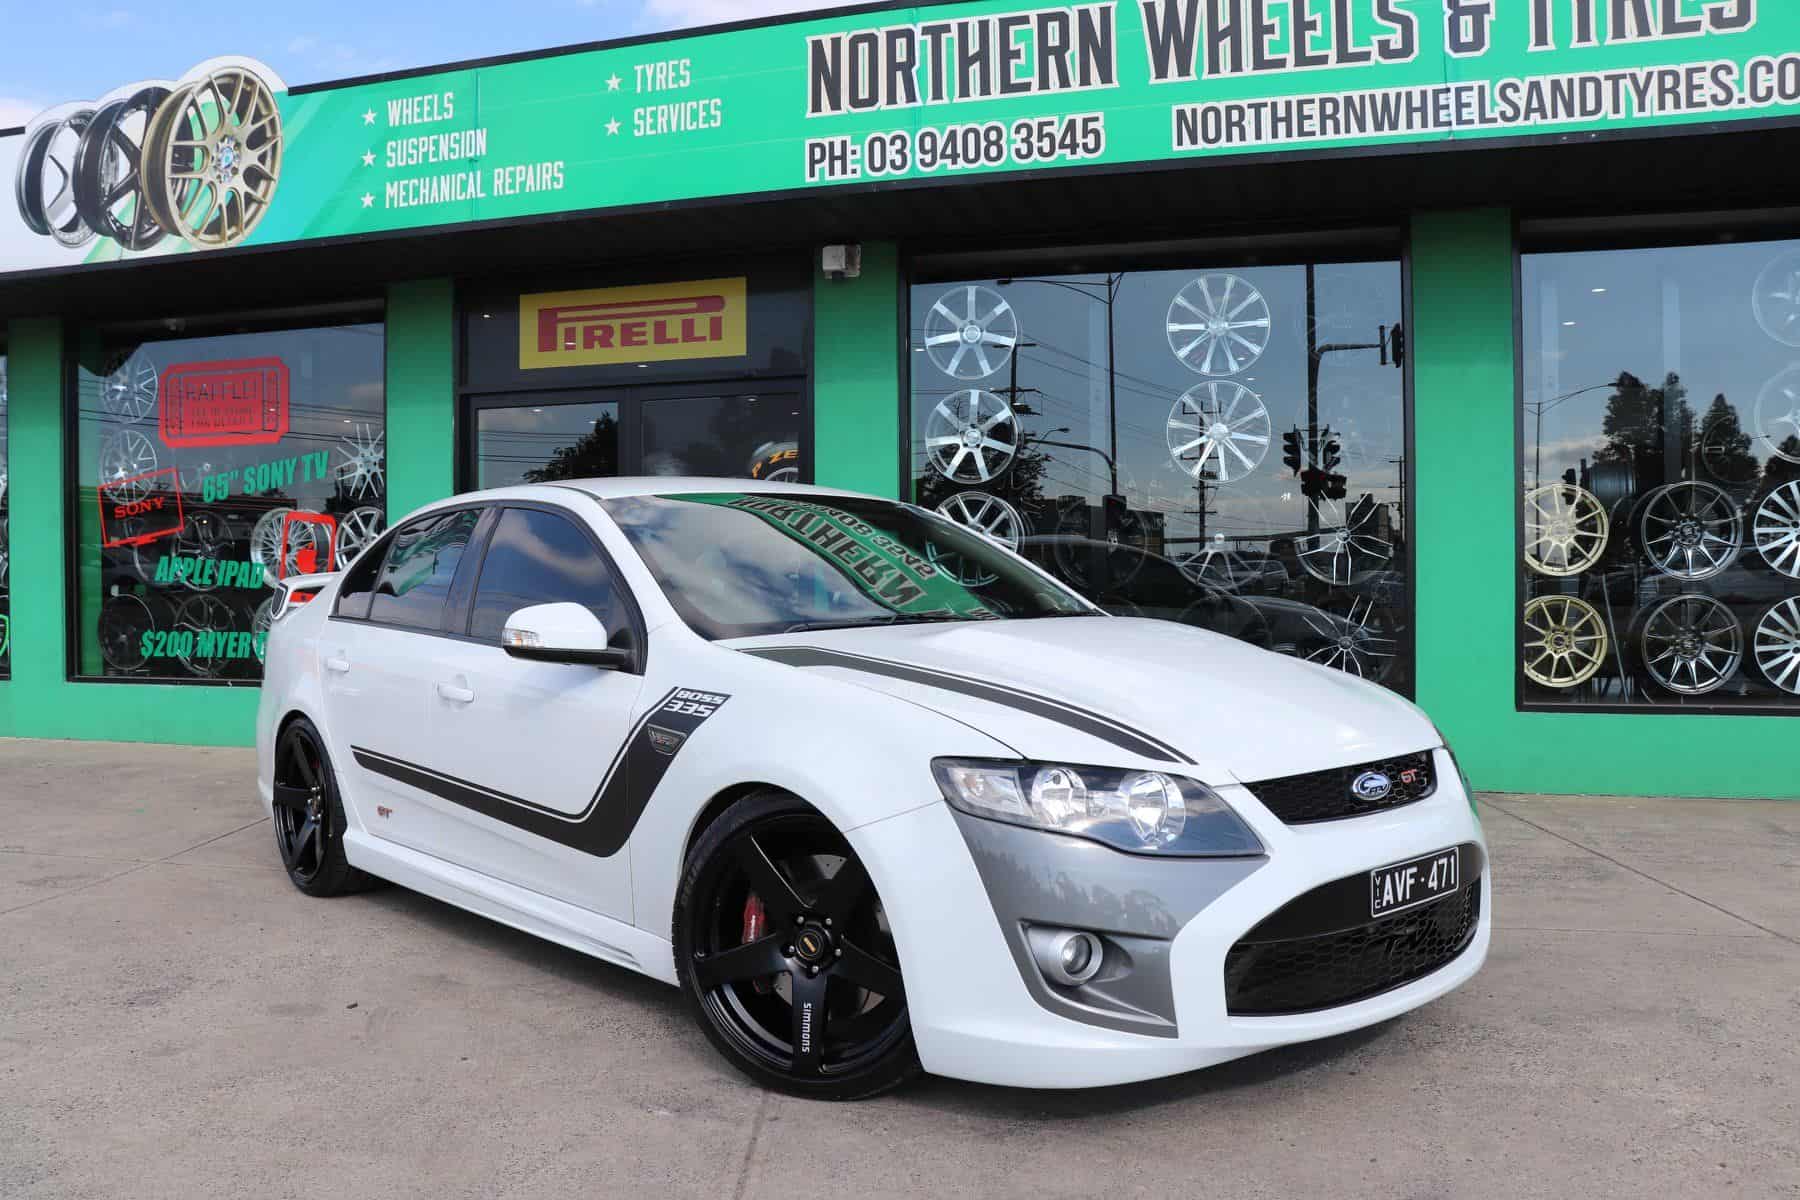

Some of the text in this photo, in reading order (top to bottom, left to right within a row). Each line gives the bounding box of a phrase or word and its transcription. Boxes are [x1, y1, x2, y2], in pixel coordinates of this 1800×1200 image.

[633, 58, 692, 93] TYRES
[808, 4, 1117, 115] NORTHERN
[1142, 0, 1416, 82] WHEELS
[387, 92, 454, 127] WHEELS
[633, 98, 722, 137] SERVICES
[386, 128, 488, 168] SUSPENSION
[807, 115, 1102, 179] PH: 03 9408 3545
[385, 161, 564, 209] MECHANICAL REPAIRS
[537, 295, 726, 353] PIRELLI
[244, 456, 300, 496] SONY
[301, 451, 329, 482] TV
[114, 496, 165, 519] SONY
[155, 556, 265, 590] APPLE IPAD
[140, 630, 194, 660] $200
[195, 631, 251, 660] MYER
[663, 699, 716, 718] 335
[675, 690, 727, 705] BOSS
